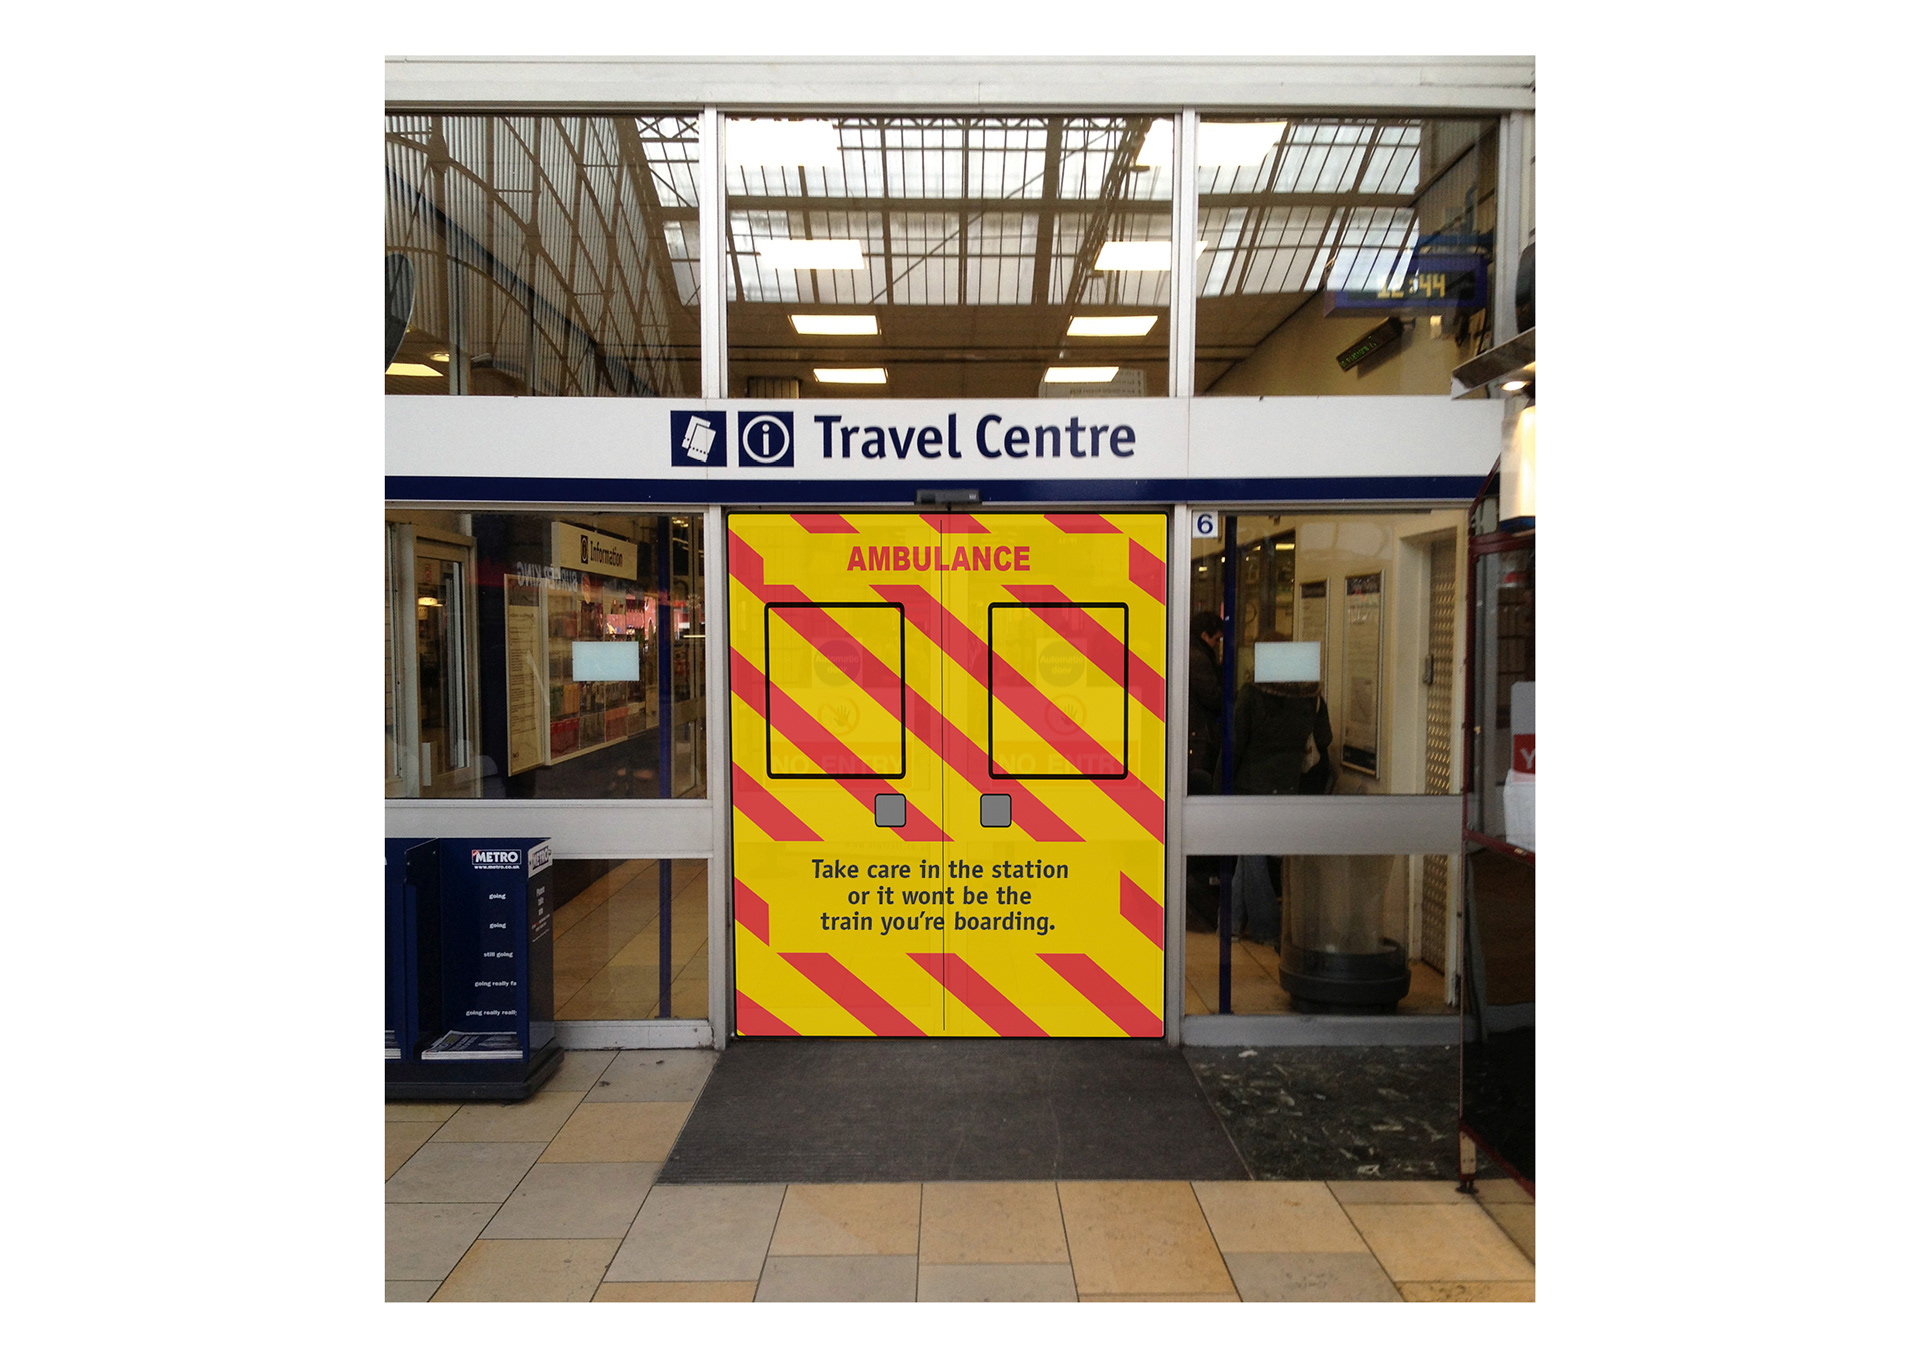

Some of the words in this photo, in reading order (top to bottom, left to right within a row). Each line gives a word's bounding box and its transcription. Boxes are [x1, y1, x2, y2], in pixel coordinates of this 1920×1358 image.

[814, 413, 962, 460] Travel
[976, 414, 1137, 459] Centre
[1197, 514, 1213, 534] 6
[590, 540, 623, 568] Information
[847, 546, 1030, 572] AMBULANCE
[475, 851, 519, 863] METRO
[811, 859, 859, 879] Take
[867, 864, 911, 879] care
[919, 859, 940, 879] in
[948, 859, 984, 879] the
[991, 859, 1069, 879] station
[847, 890, 871, 905] or
[876, 886, 895, 905] it
[902, 886, 955, 905] wont
[962, 886, 989, 905] be
[996, 886, 1032, 905] the
[820, 911, 873, 931] train
[954, 911, 1056, 936] boarding.
